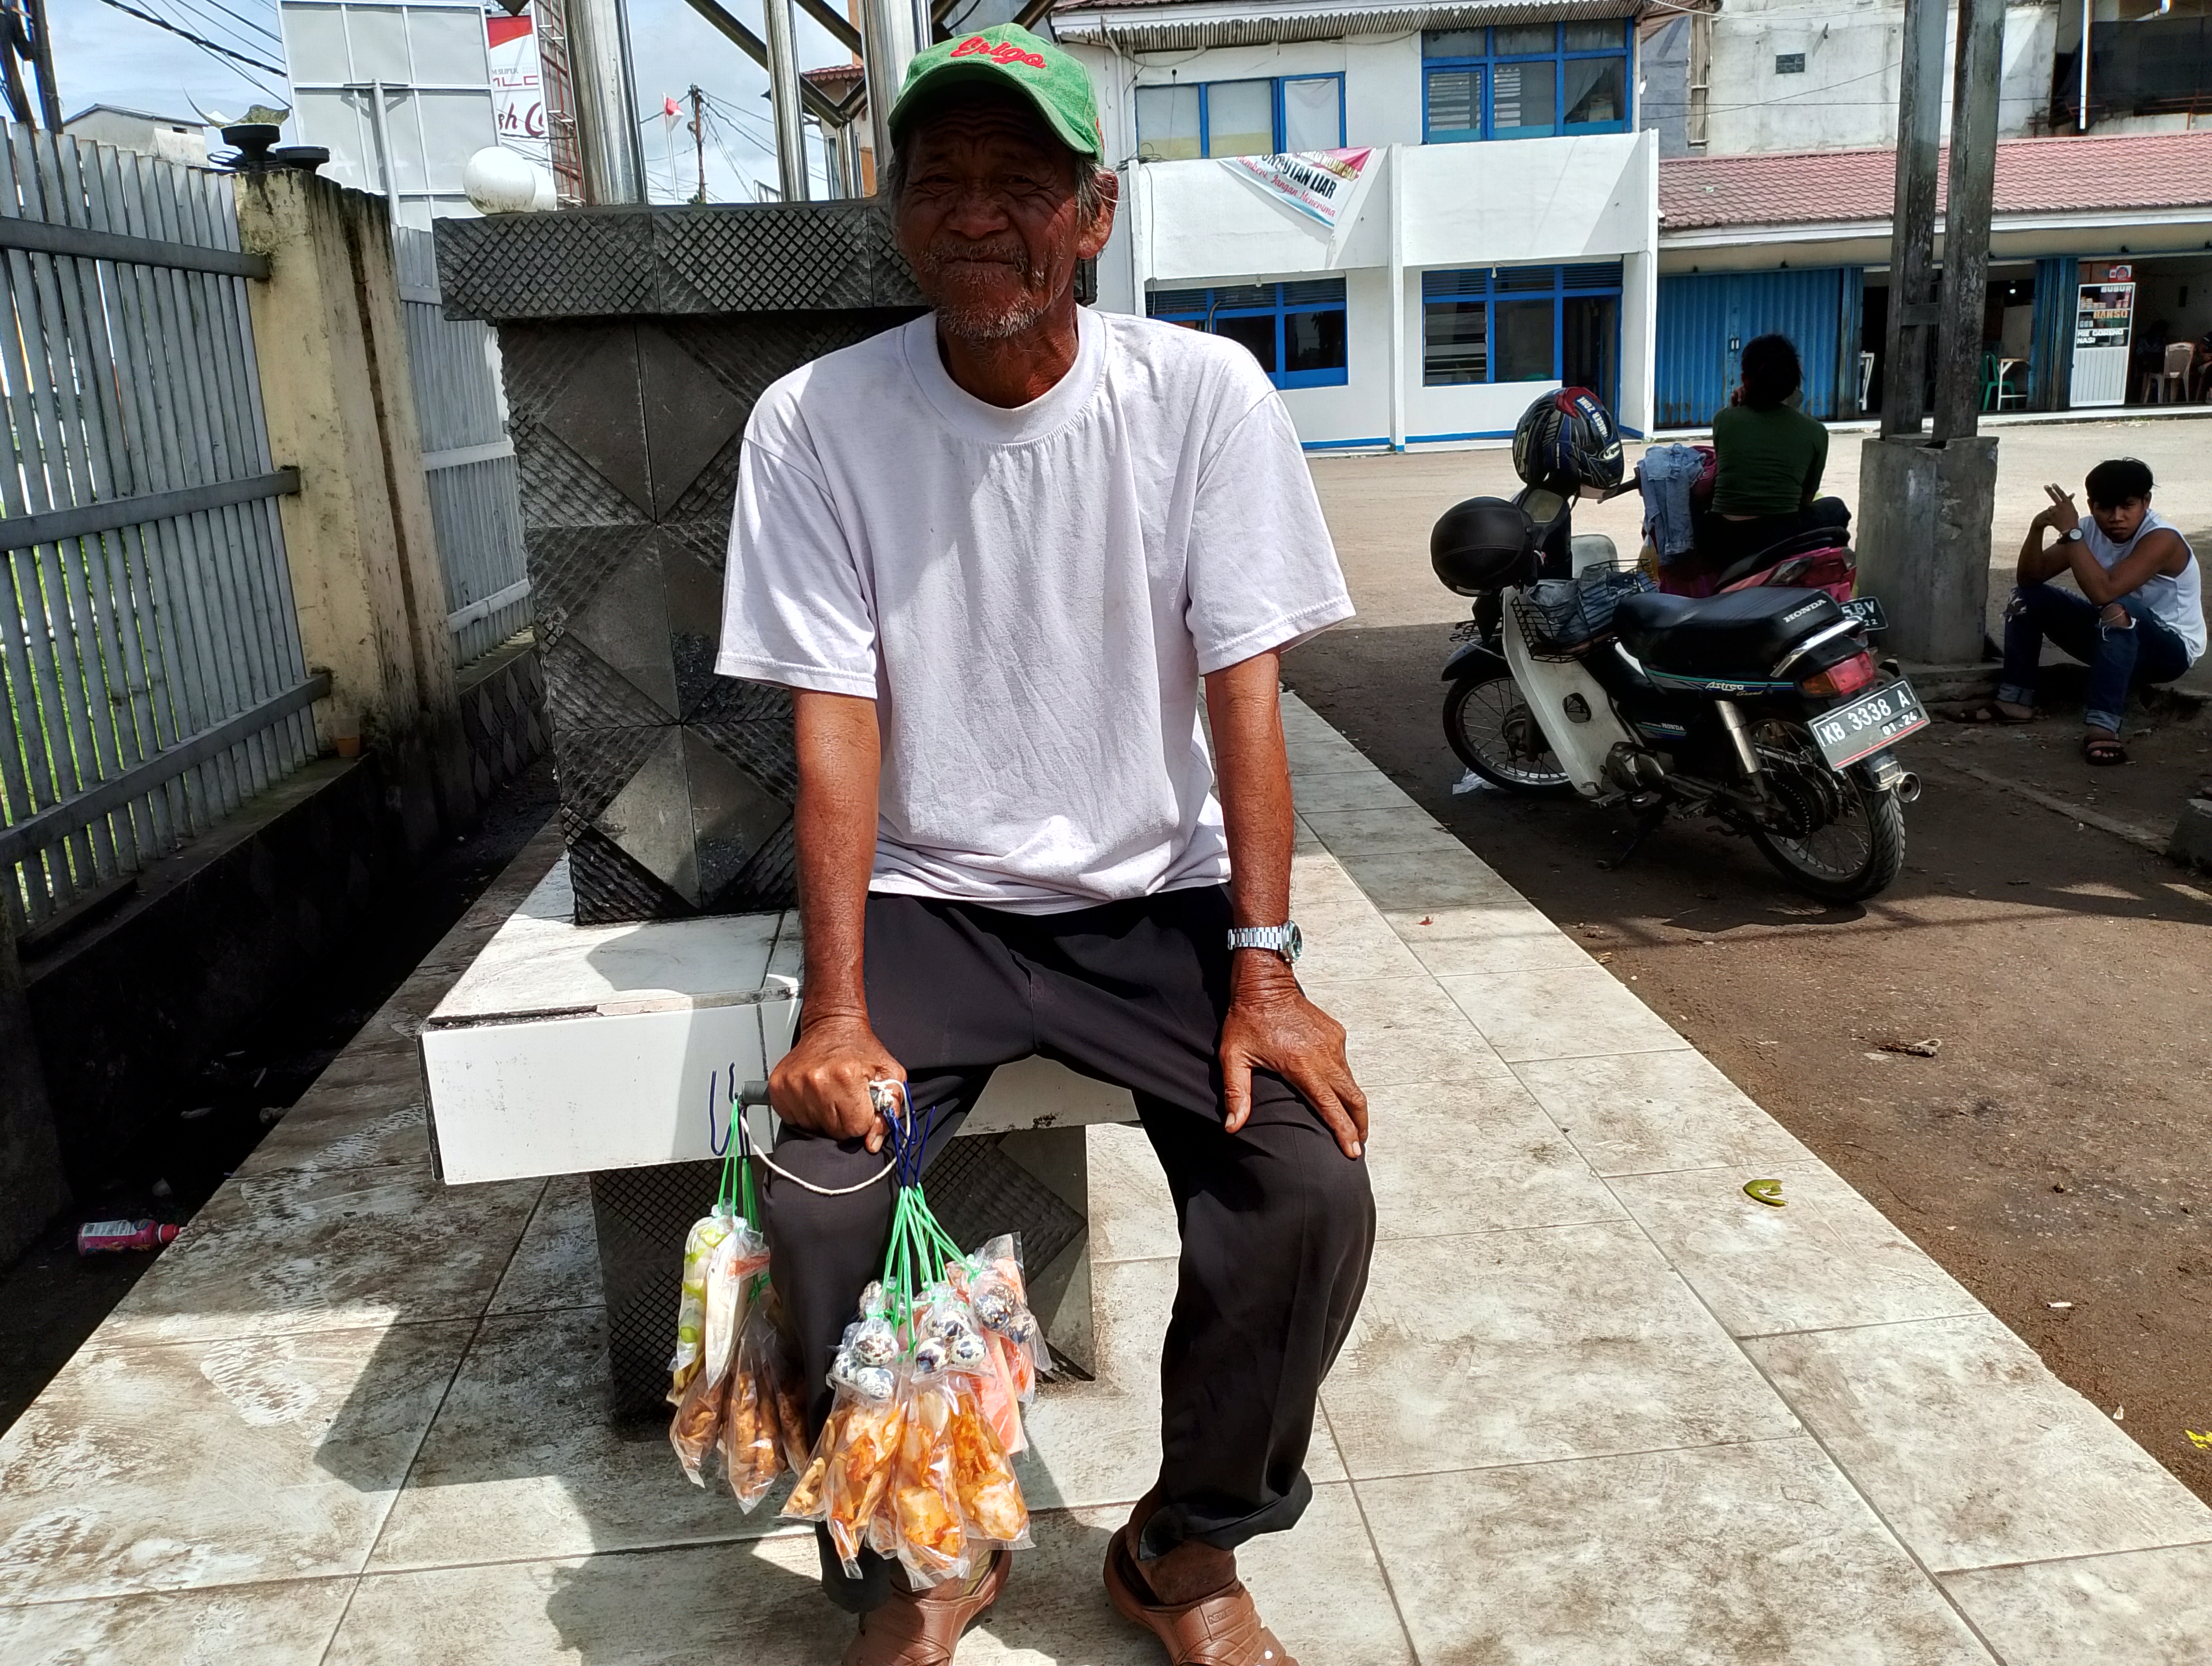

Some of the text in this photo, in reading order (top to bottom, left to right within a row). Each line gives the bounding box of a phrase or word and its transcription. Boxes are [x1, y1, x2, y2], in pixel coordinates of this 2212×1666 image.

[950, 36, 1047, 69] Erigo
[1270, 174, 1298, 197] Jangan
[1299, 190, 1336, 217] Menerima
[1309, 172, 1338, 200] LIAR
[2101, 285, 2132, 293] BUBUR
[1783, 599, 1827, 623] HONDA
[1705, 681, 1745, 691] Astrea
[1661, 722, 1685, 731] HONDA
[1820, 689, 1911, 744] KB 3338 A
